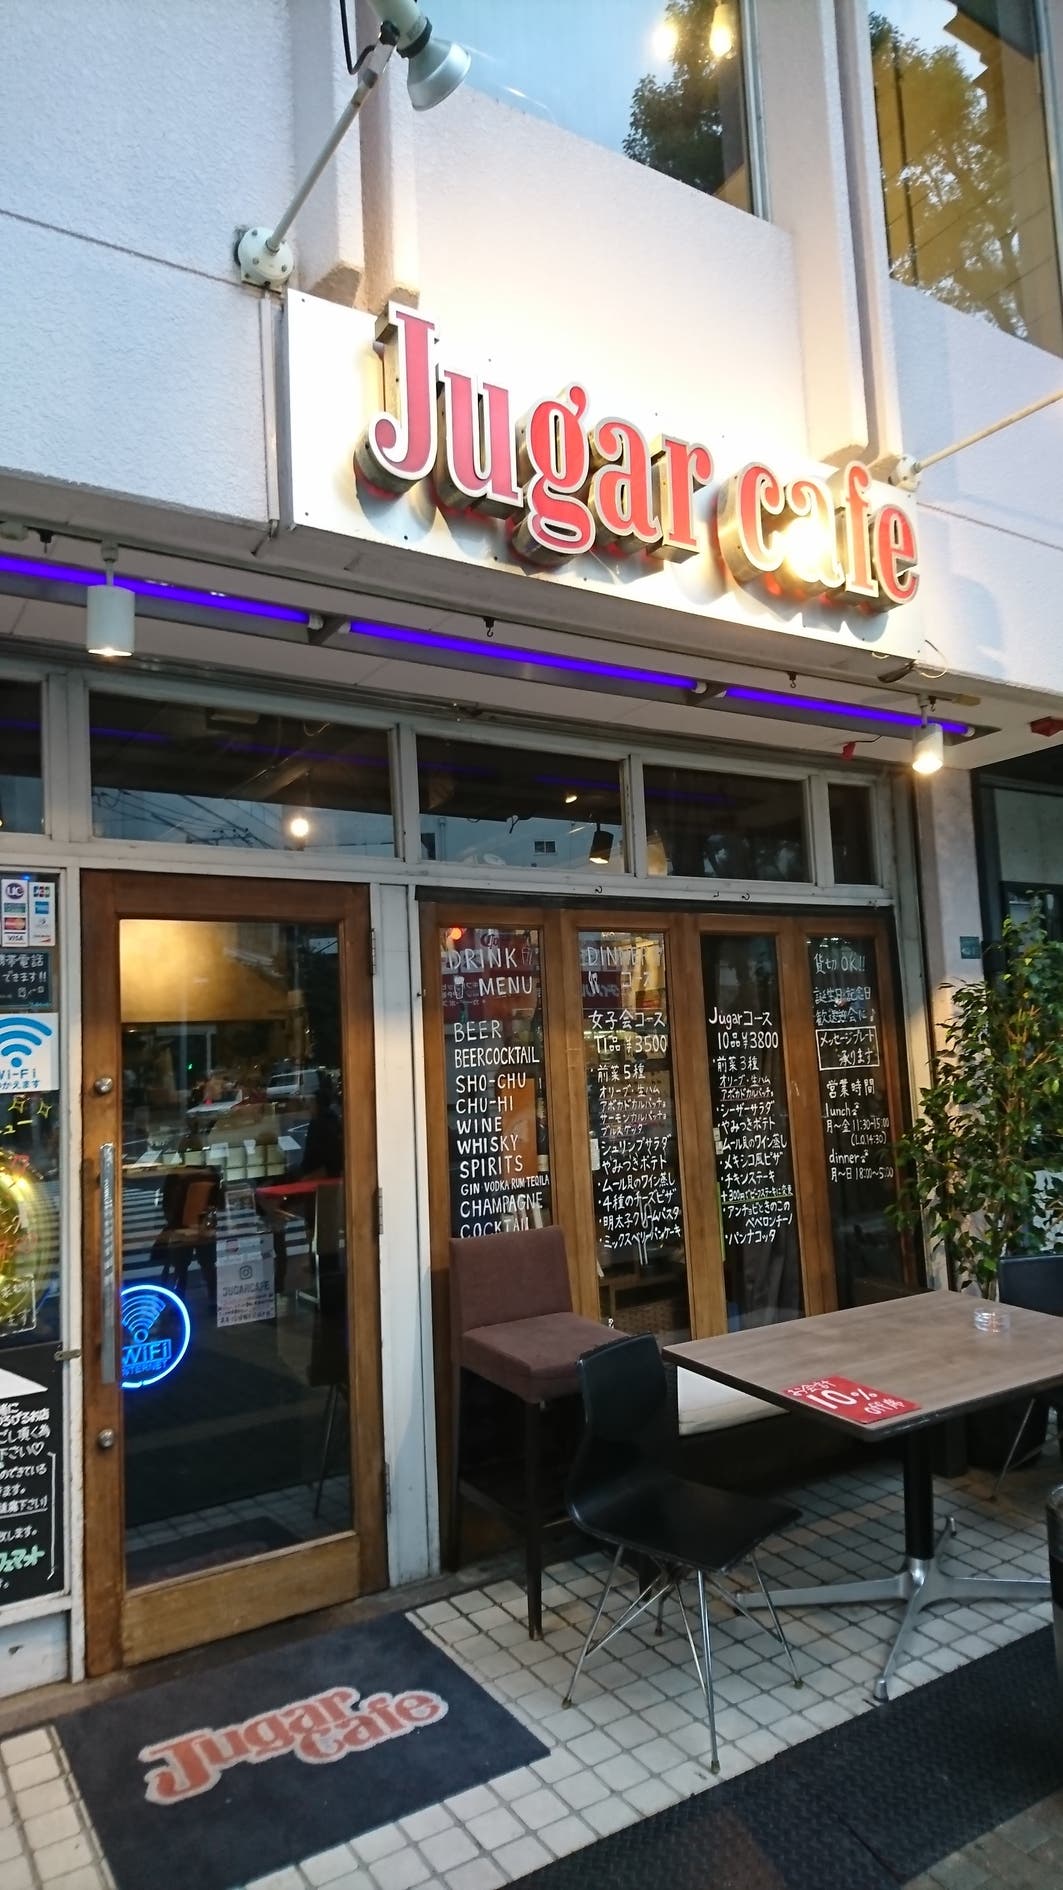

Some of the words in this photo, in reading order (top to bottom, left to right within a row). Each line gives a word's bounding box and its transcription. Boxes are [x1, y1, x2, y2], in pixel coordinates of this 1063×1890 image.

[373, 301, 715, 553] Jugar
[737, 460, 920, 605] cafe
[448, 948, 517, 969] DRINK
[479, 976, 532, 996] MENU
[588, 1009, 665, 1029] 女子会コース
[454, 1020, 501, 1042] BEER
[0, 1080, 40, 1089] かえます
[456, 1072, 526, 1093] SHO-CHU
[826, 1079, 875, 1099] 営業時間
[456, 1096, 513, 1114] CHU-HI
[457, 1117, 502, 1134] WINE
[457, 1135, 518, 1154] WHISKY
[829, 1148, 860, 1164] dinner
[460, 1155, 523, 1178] SPIRITS
[461, 1183, 480, 1196] GIN
[484, 1180, 509, 1192] VODKA
[461, 1192, 543, 1217] CHAMPAGNE
[141, 1690, 357, 1802] Jugar
